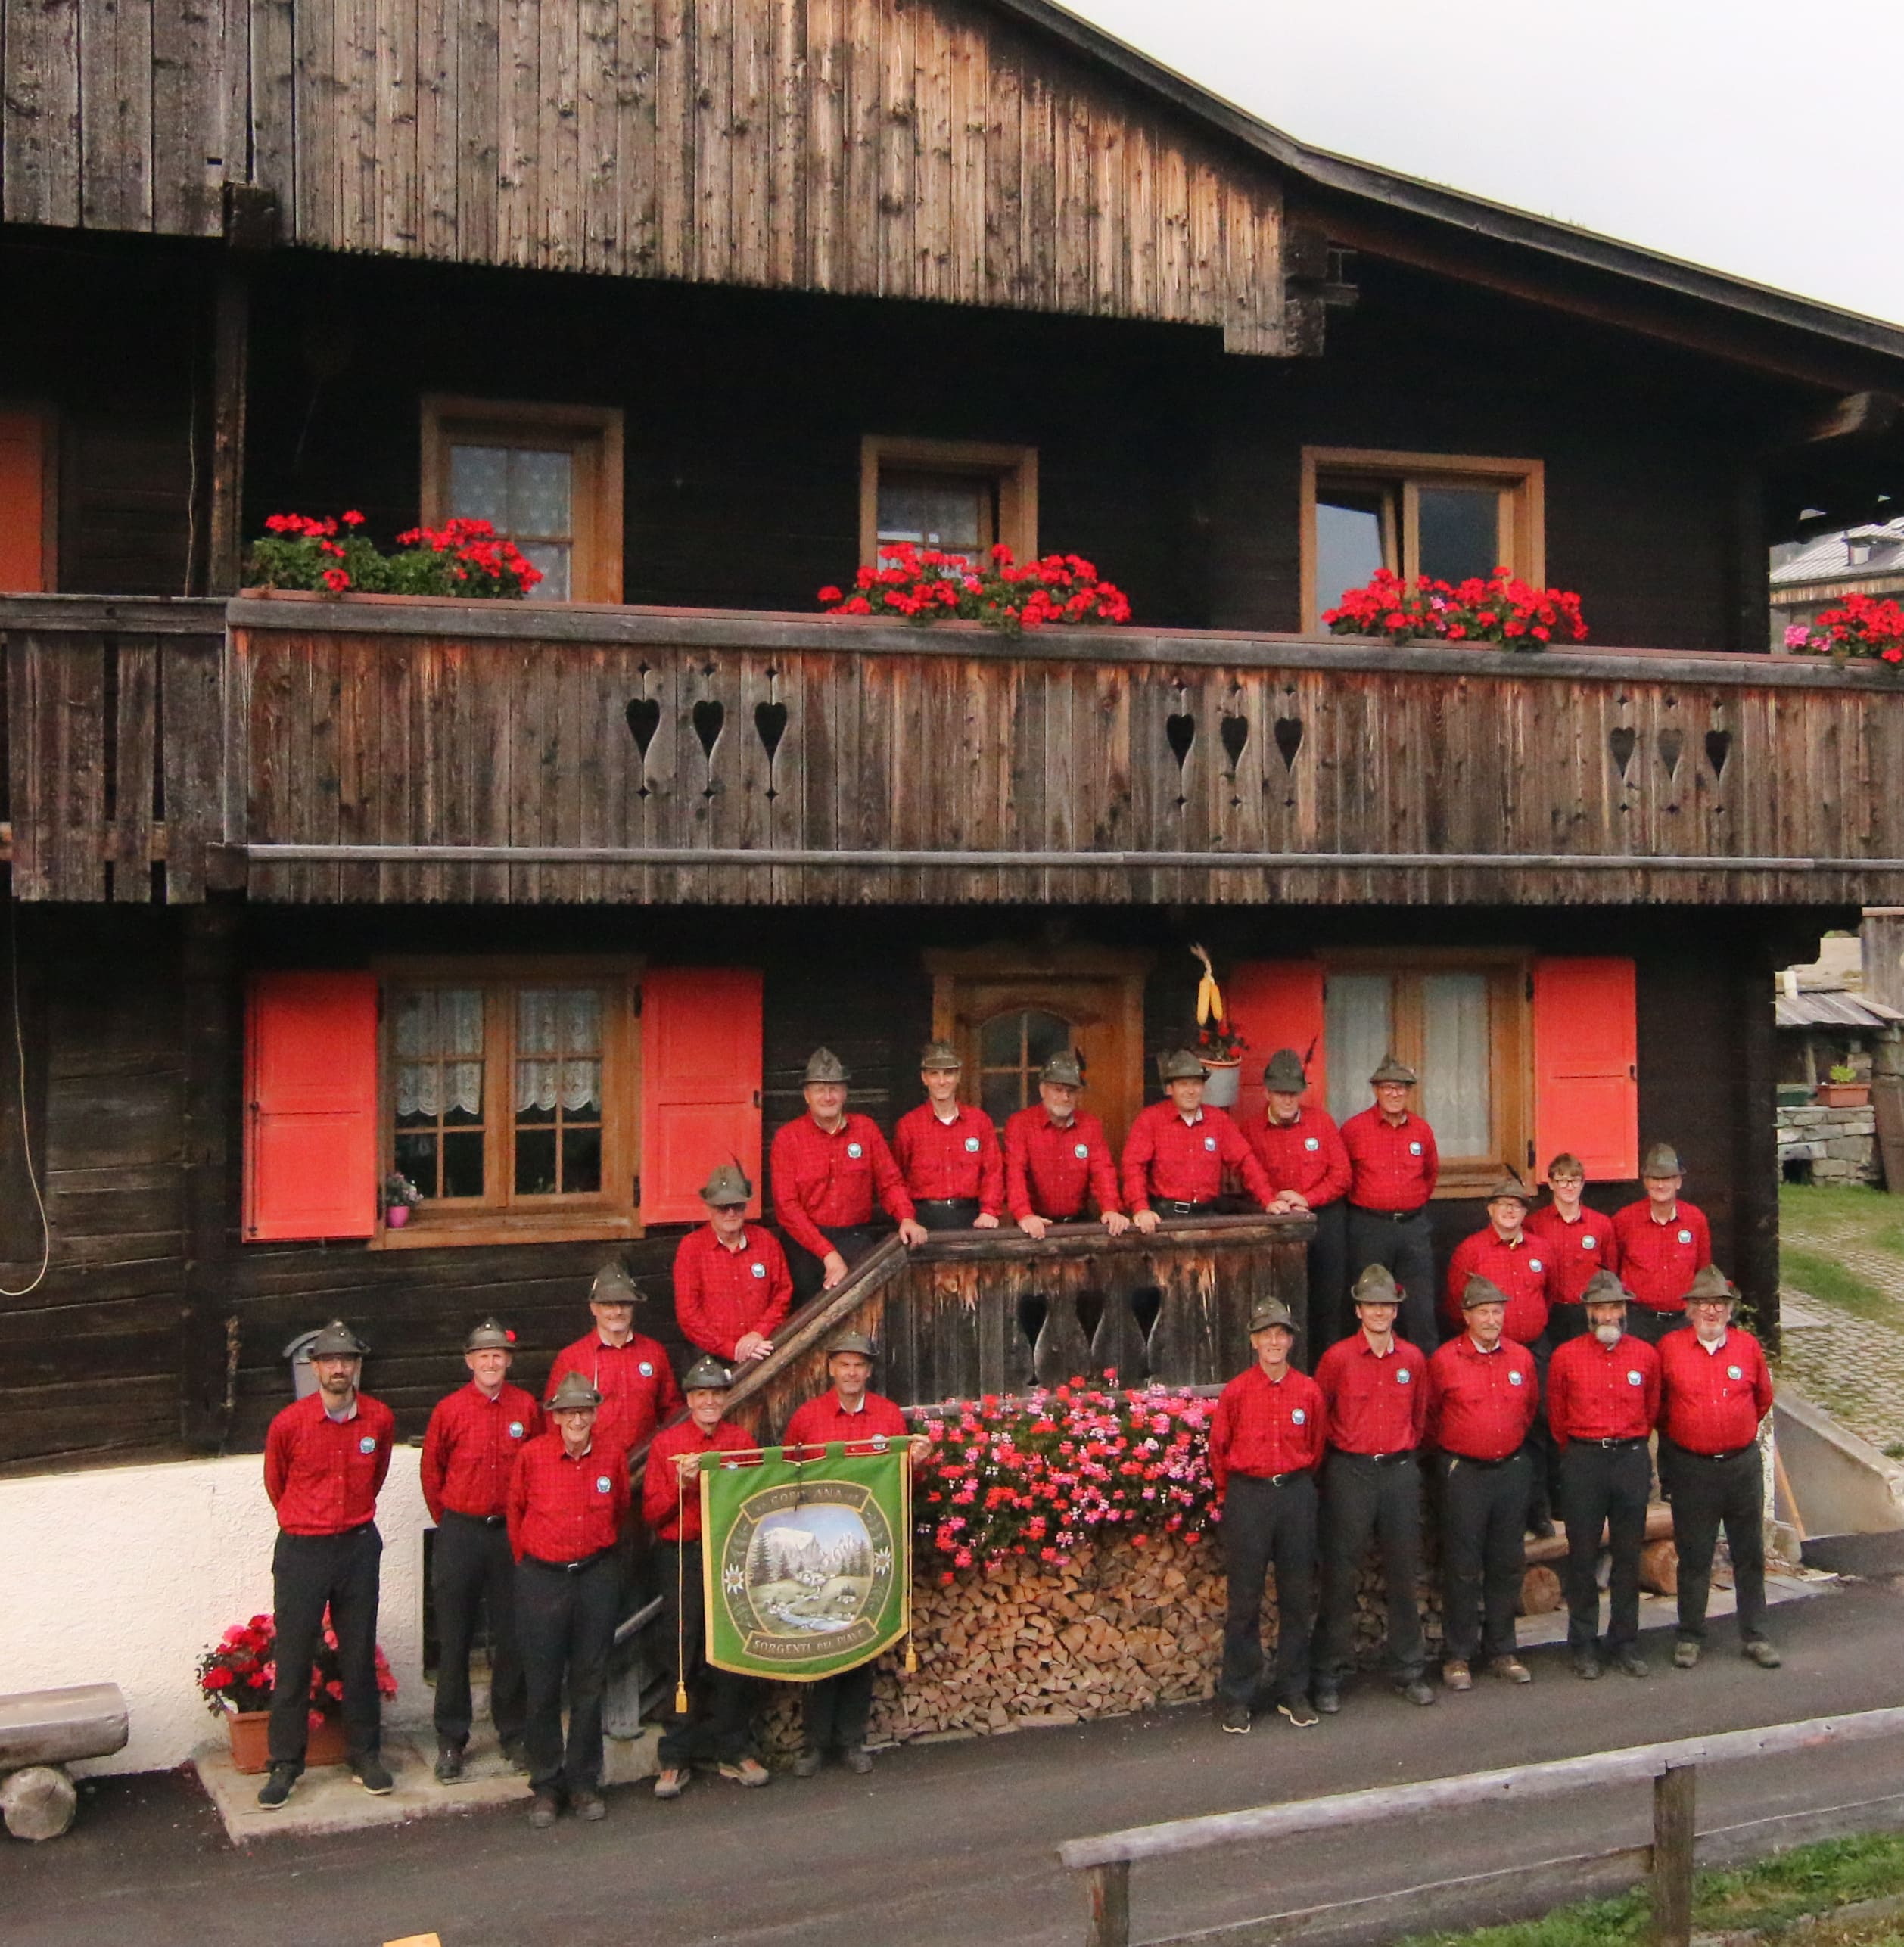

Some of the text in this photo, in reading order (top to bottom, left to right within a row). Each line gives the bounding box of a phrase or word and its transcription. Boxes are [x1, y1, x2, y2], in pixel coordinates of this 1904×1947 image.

[813, 1488, 842, 1499] ANA
[754, 1640, 811, 1654] SORGENTI
[837, 1629, 863, 1647] PIAVE
